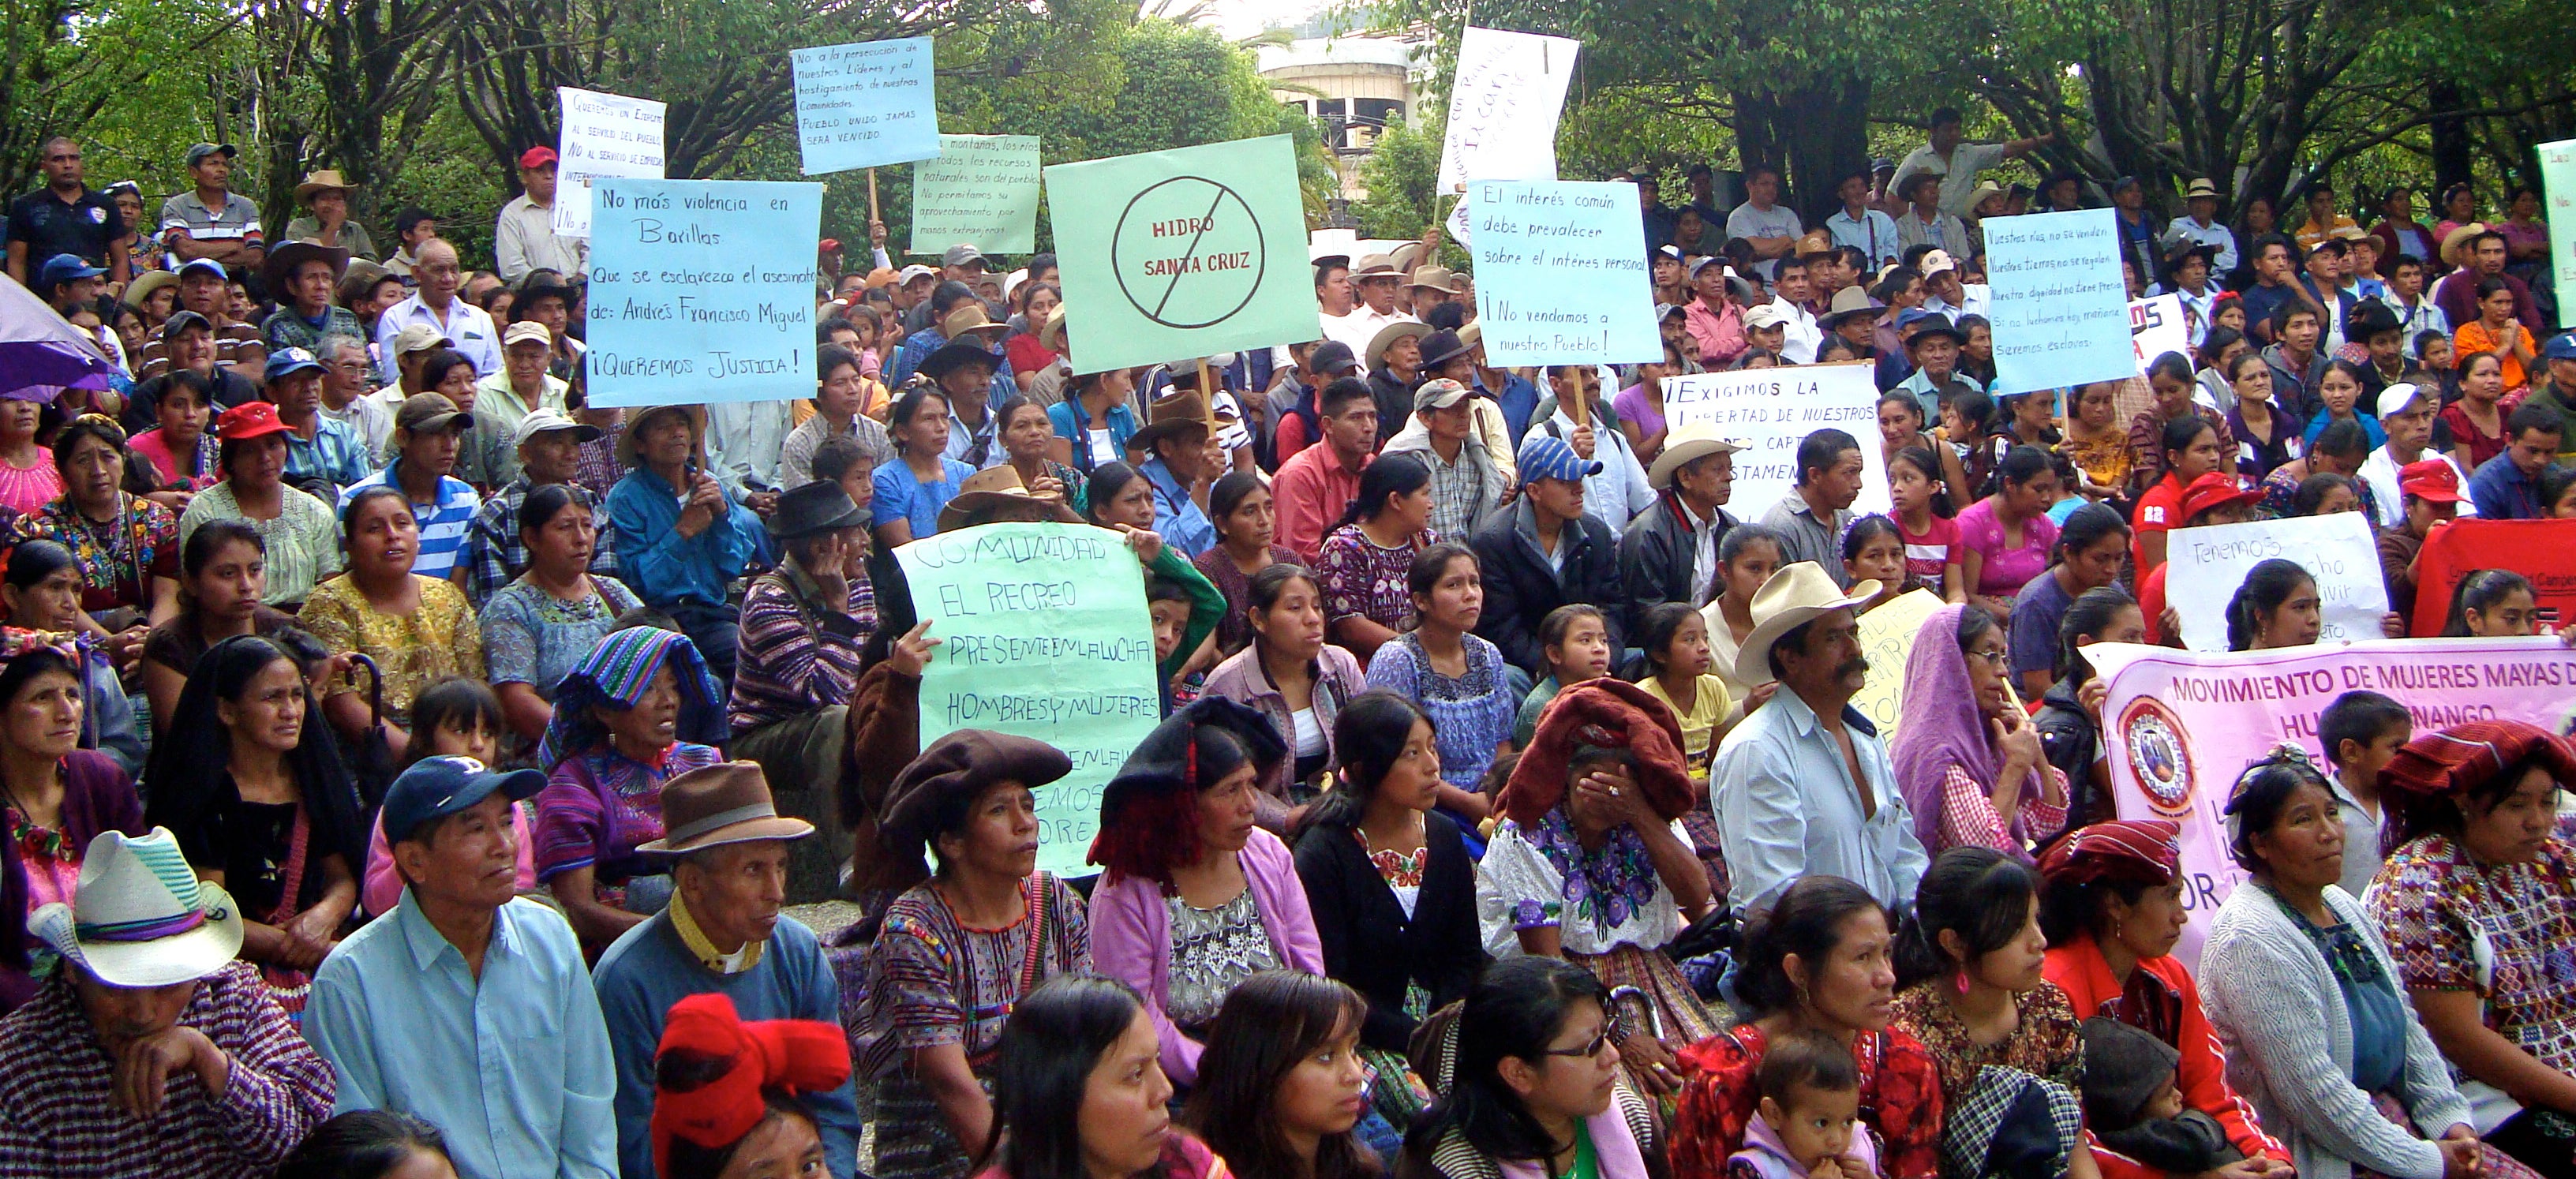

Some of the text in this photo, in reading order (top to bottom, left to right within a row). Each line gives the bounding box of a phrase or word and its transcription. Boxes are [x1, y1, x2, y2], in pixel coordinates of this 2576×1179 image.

[797, 54, 811, 64] No
[829, 48, 840, 61] la
[905, 43, 917, 52] de
[798, 66, 839, 79] nuestros
[889, 66, 896, 75] y
[901, 58, 913, 69] al
[799, 77, 919, 97] hostigamiento de nuestras
[801, 110, 916, 129] PUEBLO UNIDO JAMAS
[572, 125, 580, 134] AL
[588, 126, 615, 139] SERVICIO
[620, 131, 633, 141] DEL
[807, 136, 829, 145] SERA
[567, 141, 582, 158] NO
[588, 150, 594, 159] AL
[600, 151, 627, 163] SERVICIO
[629, 155, 638, 165] DE
[950, 137, 999, 152] montañas,
[1002, 137, 1017, 150] los
[1019, 139, 1039, 152] ríos
[971, 154, 984, 166] los
[989, 159, 1031, 168] recursos
[923, 170, 968, 182] naturales
[994, 172, 1007, 182] del
[603, 189, 788, 211] No más violencia en
[921, 188, 932, 199] No
[936, 188, 992, 204] permitamos
[1485, 185, 1615, 210] El interés común
[919, 204, 1015, 220] aprovechamiento por
[953, 223, 1005, 238] extranjeras
[1152, 215, 1215, 238] HIDRO
[1483, 215, 1518, 234] debe
[1528, 219, 1602, 241] prevalecer
[1988, 228, 2026, 245] Nuestros
[2050, 232, 2061, 241] no
[2063, 230, 2074, 239] se
[1144, 251, 1251, 276] SANTA CRUZ
[1485, 246, 1521, 265] sobre
[1533, 249, 1544, 266] el
[2070, 257, 2080, 266] se
[593, 265, 816, 285] Que se esclarezca el asesinato
[1990, 286, 2024, 301] Nuestra
[2064, 286, 2074, 295] no
[2076, 279, 2096, 294] tiene
[591, 296, 806, 332] de: Andrés Francisco Miguel
[1527, 308, 1588, 324] vendamos
[1600, 314, 1608, 324] a
[1994, 316, 2005, 327] Si
[2009, 319, 2021, 328] no
[2026, 309, 2065, 327] luchamos
[1500, 330, 1608, 357] nuestro Pueblo!
[708, 349, 799, 378] JUSTICIA!
[1797, 382, 1818, 395] LA
[1776, 408, 1792, 422] DE
[1803, 406, 1875, 422] NUESTROS
[1731, 464, 1799, 481] STAMEN
[915, 536, 1106, 568] COMUNIDAD
[939, 581, 1076, 617] EL RECREO
[2173, 668, 2334, 702] MOVIMIENTO
[2341, 665, 2374, 689] DE
[2376, 664, 2479, 689] MUJERES
[2484, 662, 2562, 688] MAYAS
[1069, 696, 1159, 719] MUJERES
[1034, 784, 1104, 812] EMOS
